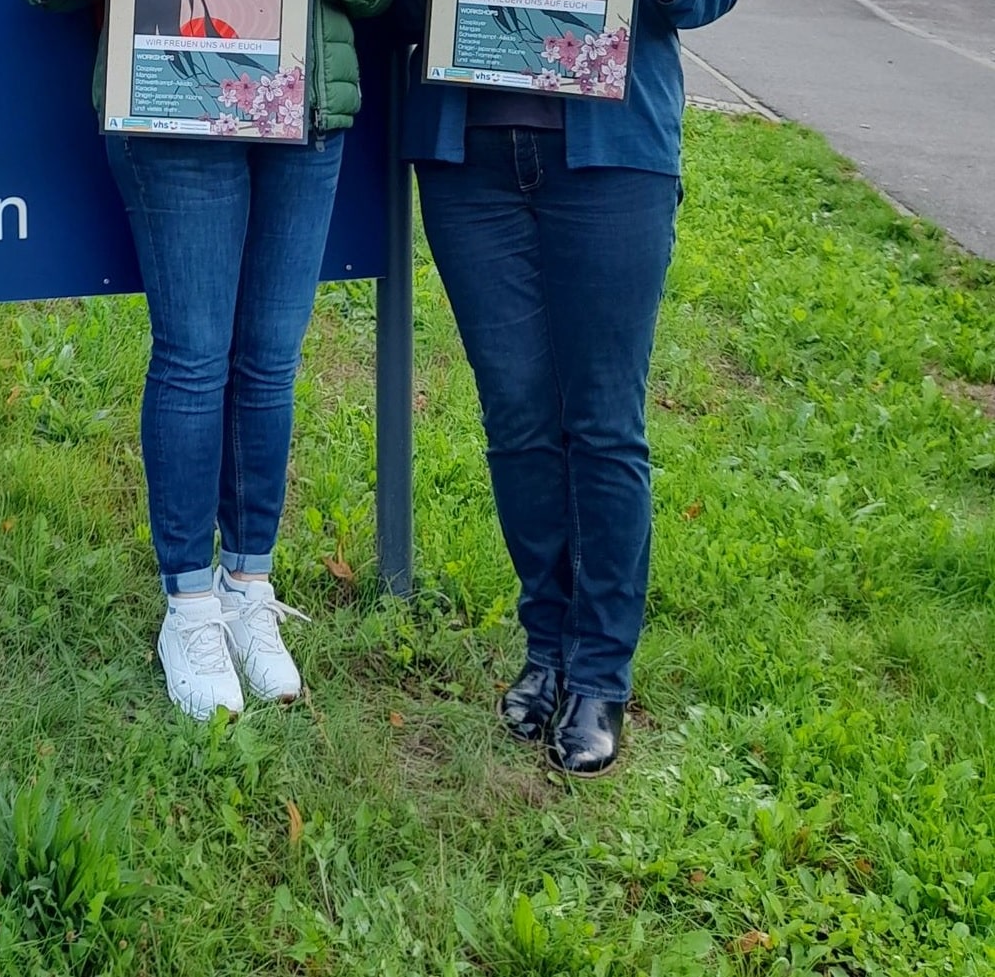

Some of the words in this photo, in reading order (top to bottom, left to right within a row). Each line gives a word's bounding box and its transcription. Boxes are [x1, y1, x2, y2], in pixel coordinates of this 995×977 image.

[544, 0, 561, 7] AUF
[564, 0, 588, 10] EUCH
[460, 8, 498, 16] WORKSHOPS
[146, 38, 162, 46] WIR
[164, 40, 198, 48] FREUEN
[200, 41, 217, 49] UNS
[238, 43, 262, 51] EUCH
[476, 72, 491, 81] vhs
[153, 120, 169, 129] vhs
